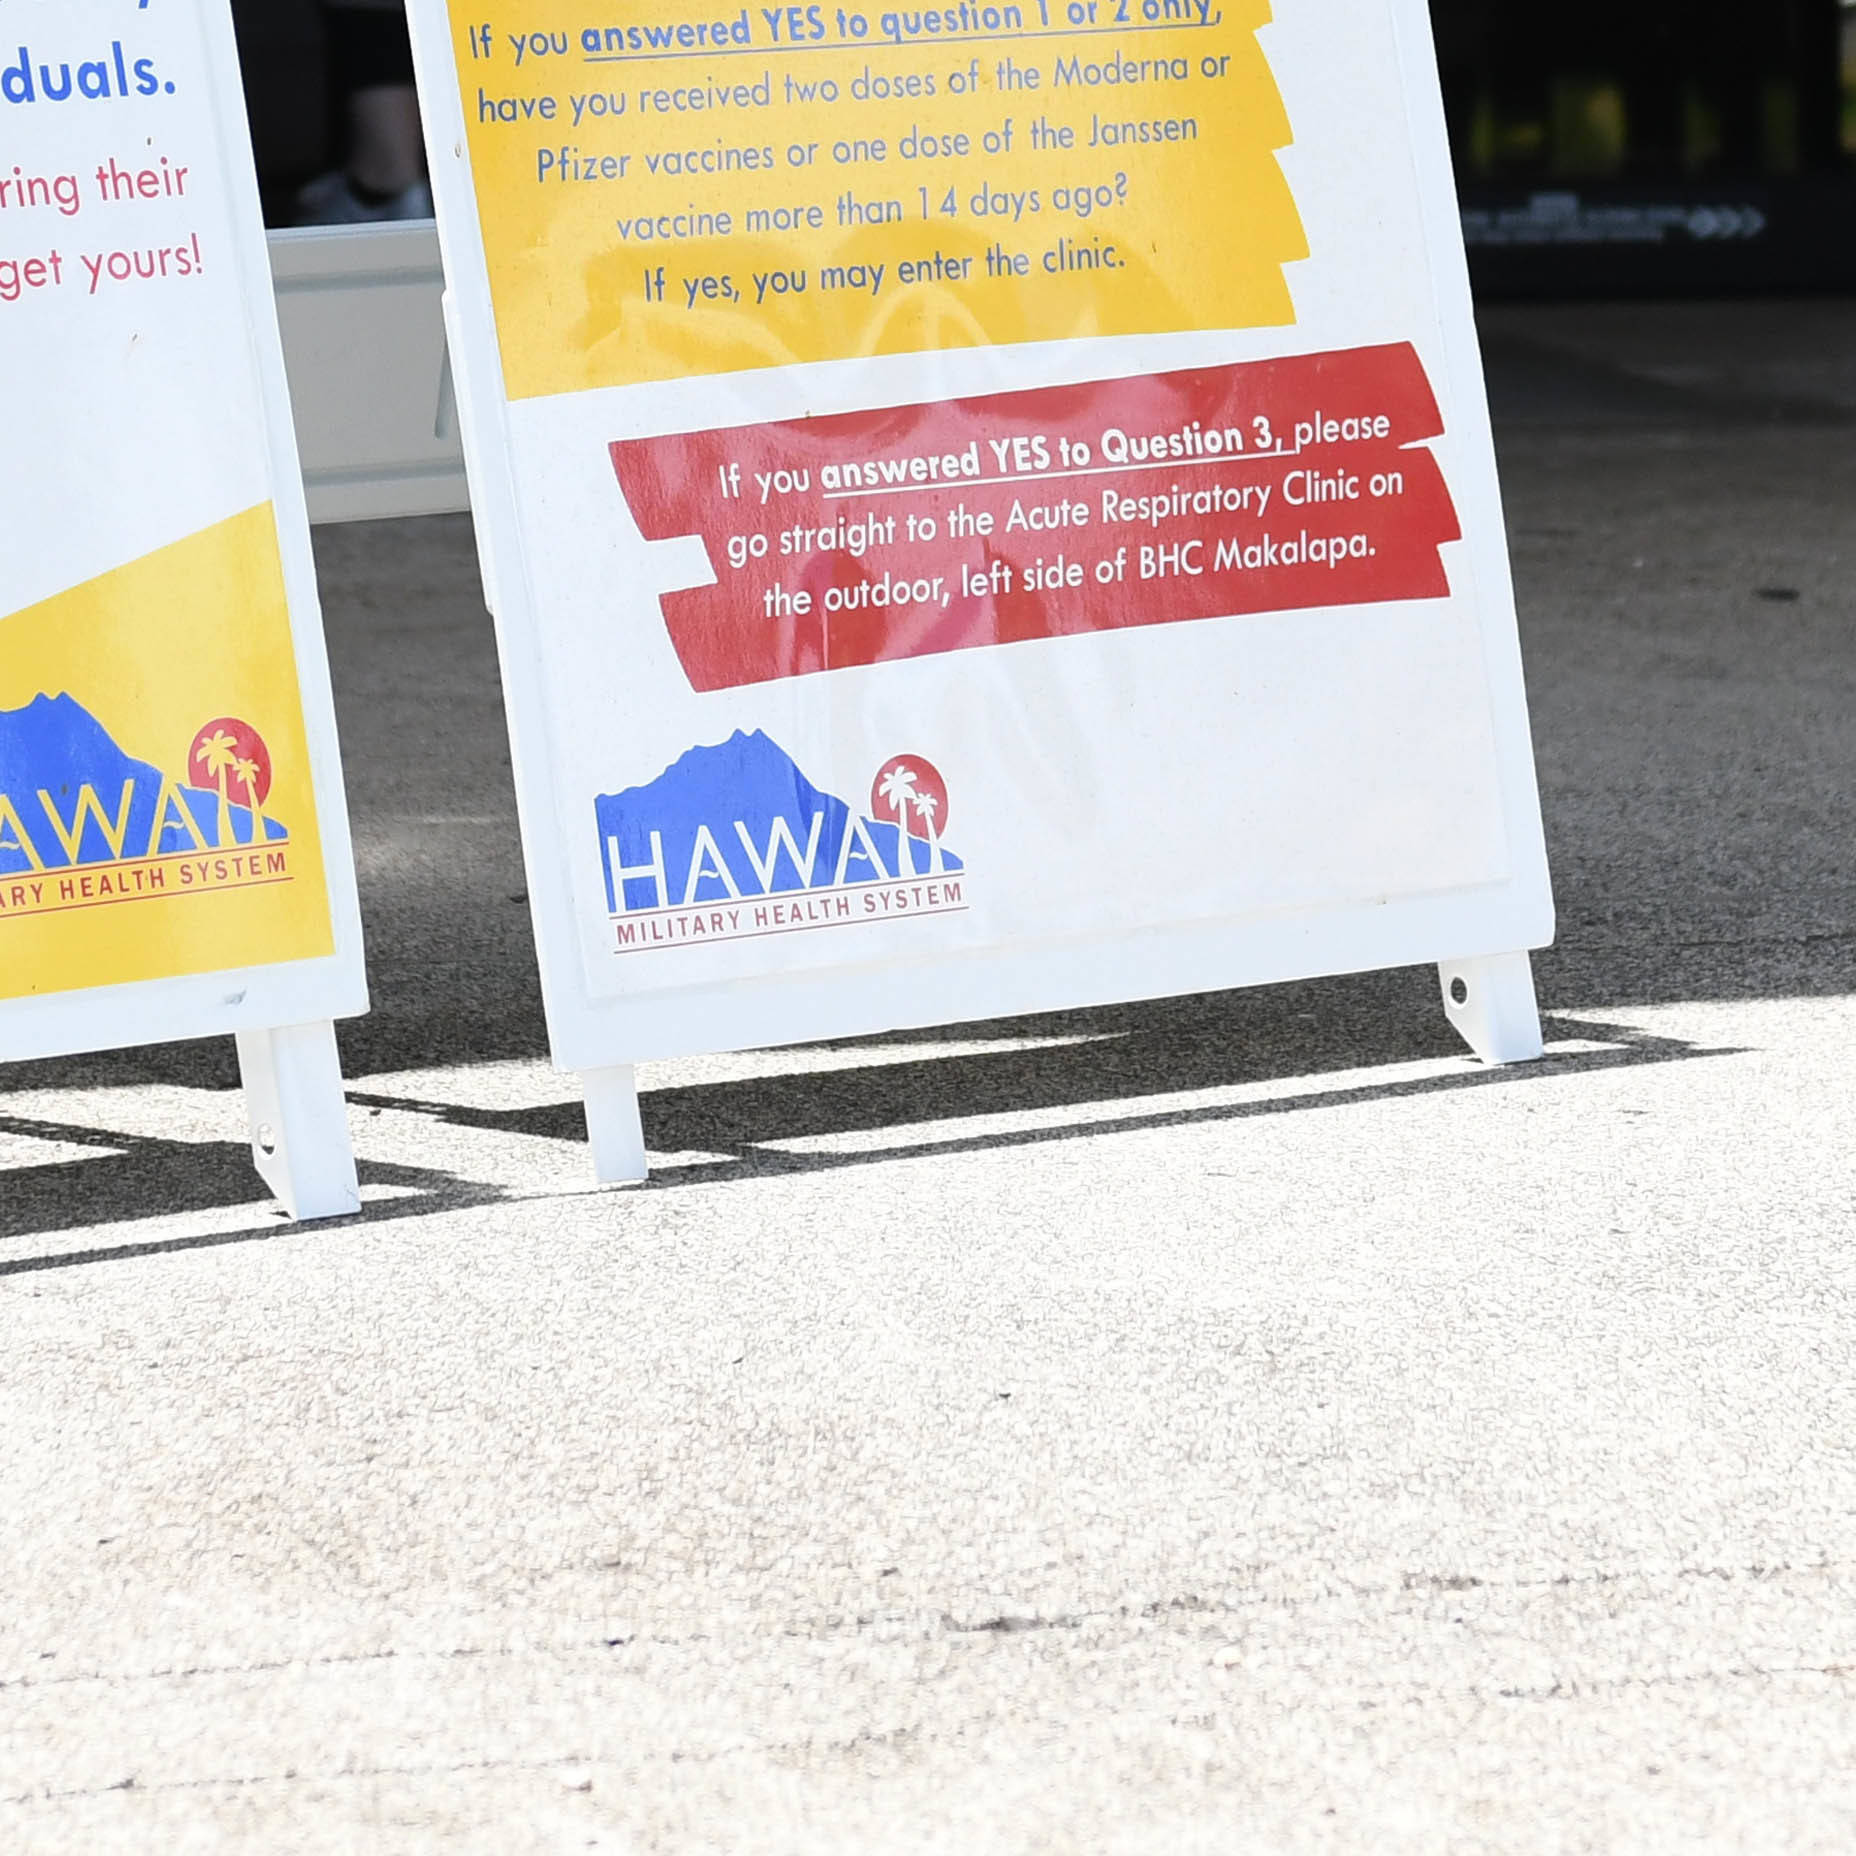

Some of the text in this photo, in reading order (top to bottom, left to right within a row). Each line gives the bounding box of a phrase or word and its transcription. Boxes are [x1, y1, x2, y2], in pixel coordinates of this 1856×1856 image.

[470, 24, 492, 58] If
[510, 32, 568, 65] you
[580, 6, 753, 55] answered
[760, 5, 825, 44] YES
[833, 6, 871, 41] to
[478, 50, 1230, 126] have you received two doses of the Moderna or
[96, 158, 188, 199] their
[538, 114, 1198, 181] Pfizer vaccines or one dose of the Janssen
[616, 171, 1128, 240] vaccine more than 14 days ago?
[83, 235, 200, 292] yours!
[645, 237, 1124, 310] If yes, you may enter the clinic.
[720, 411, 1389, 504] If you answered YES to Question 3, please
[728, 469, 1402, 568] go straight to the Acute Respiratory Clinic on
[764, 530, 1375, 617] the outdoor, left side of BHC Makalapa.
[59, 865, 165, 901] HEALTH
[179, 851, 287, 886] SYSTEM
[616, 881, 963, 946] MILITARY HEALTH SYSTEM
